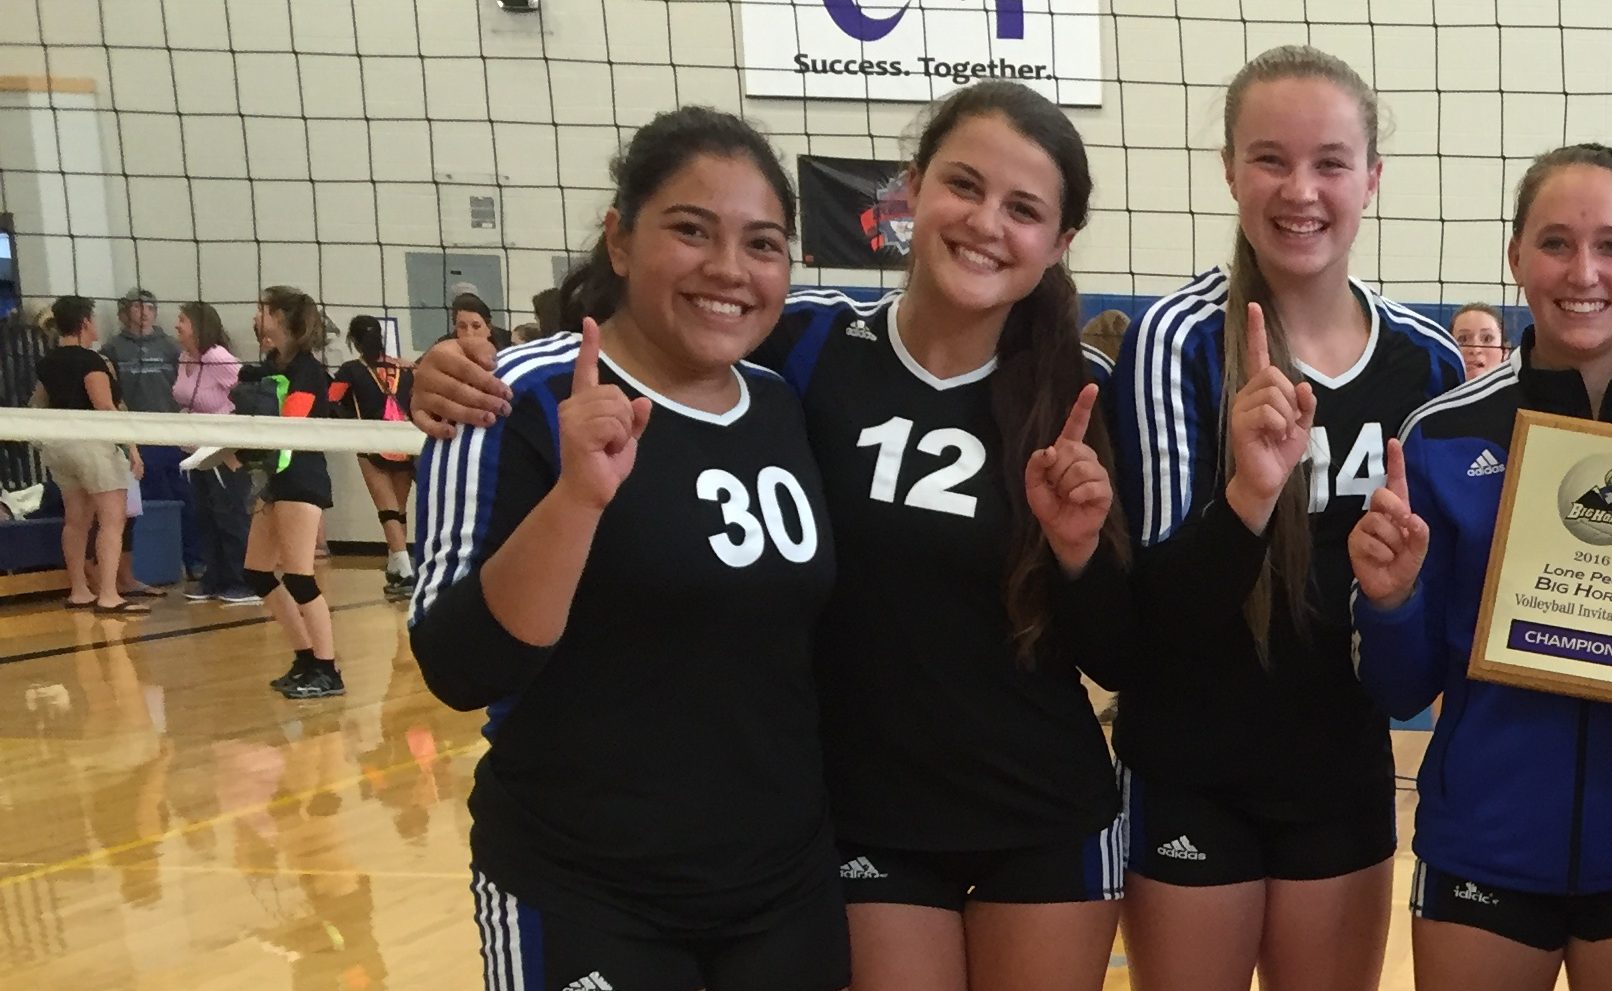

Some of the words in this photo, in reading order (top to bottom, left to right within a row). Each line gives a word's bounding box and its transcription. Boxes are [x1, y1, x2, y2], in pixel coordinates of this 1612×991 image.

[794, 54, 911, 77] Success.
[917, 57, 1053, 84] Together.
[856, 416, 986, 518] 12
[1300, 422, 1388, 513] 14
[1467, 463, 1505, 477] adidas
[696, 466, 818, 567] 30
[1574, 551, 1611, 566] 2016
[1543, 563, 1585, 580] Lone
[1515, 593, 1575, 614] Volleyball
[1157, 847, 1206, 860] adidas
